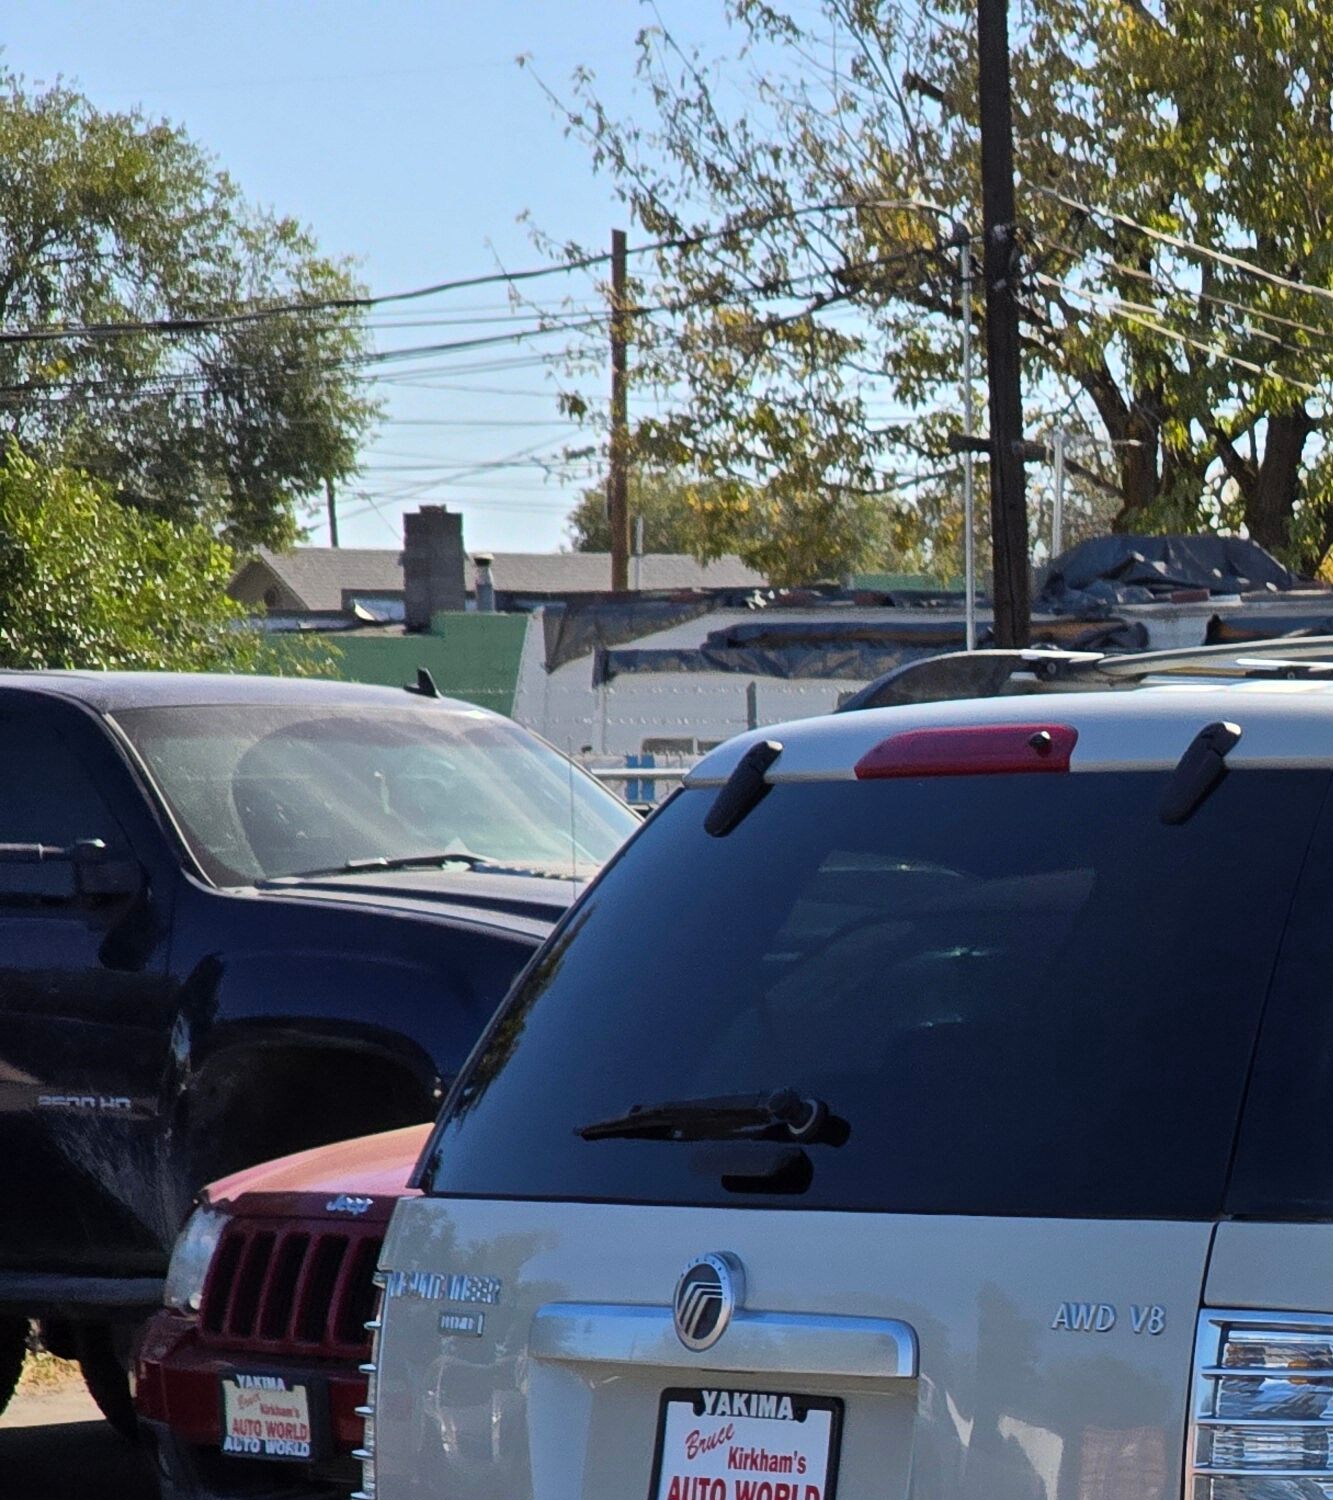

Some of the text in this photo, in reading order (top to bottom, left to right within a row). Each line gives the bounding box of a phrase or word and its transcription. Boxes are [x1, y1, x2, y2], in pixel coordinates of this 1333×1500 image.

[1051, 1302, 1166, 1334] AWD V8
[702, 1390, 794, 1420] YAKIMA
[232, 1418, 307, 1441] AUTO WORLD
[685, 1423, 735, 1460] Bruce
[223, 1436, 310, 1457] AUTO WORLD
[728, 1446, 806, 1474] Kirkham's
